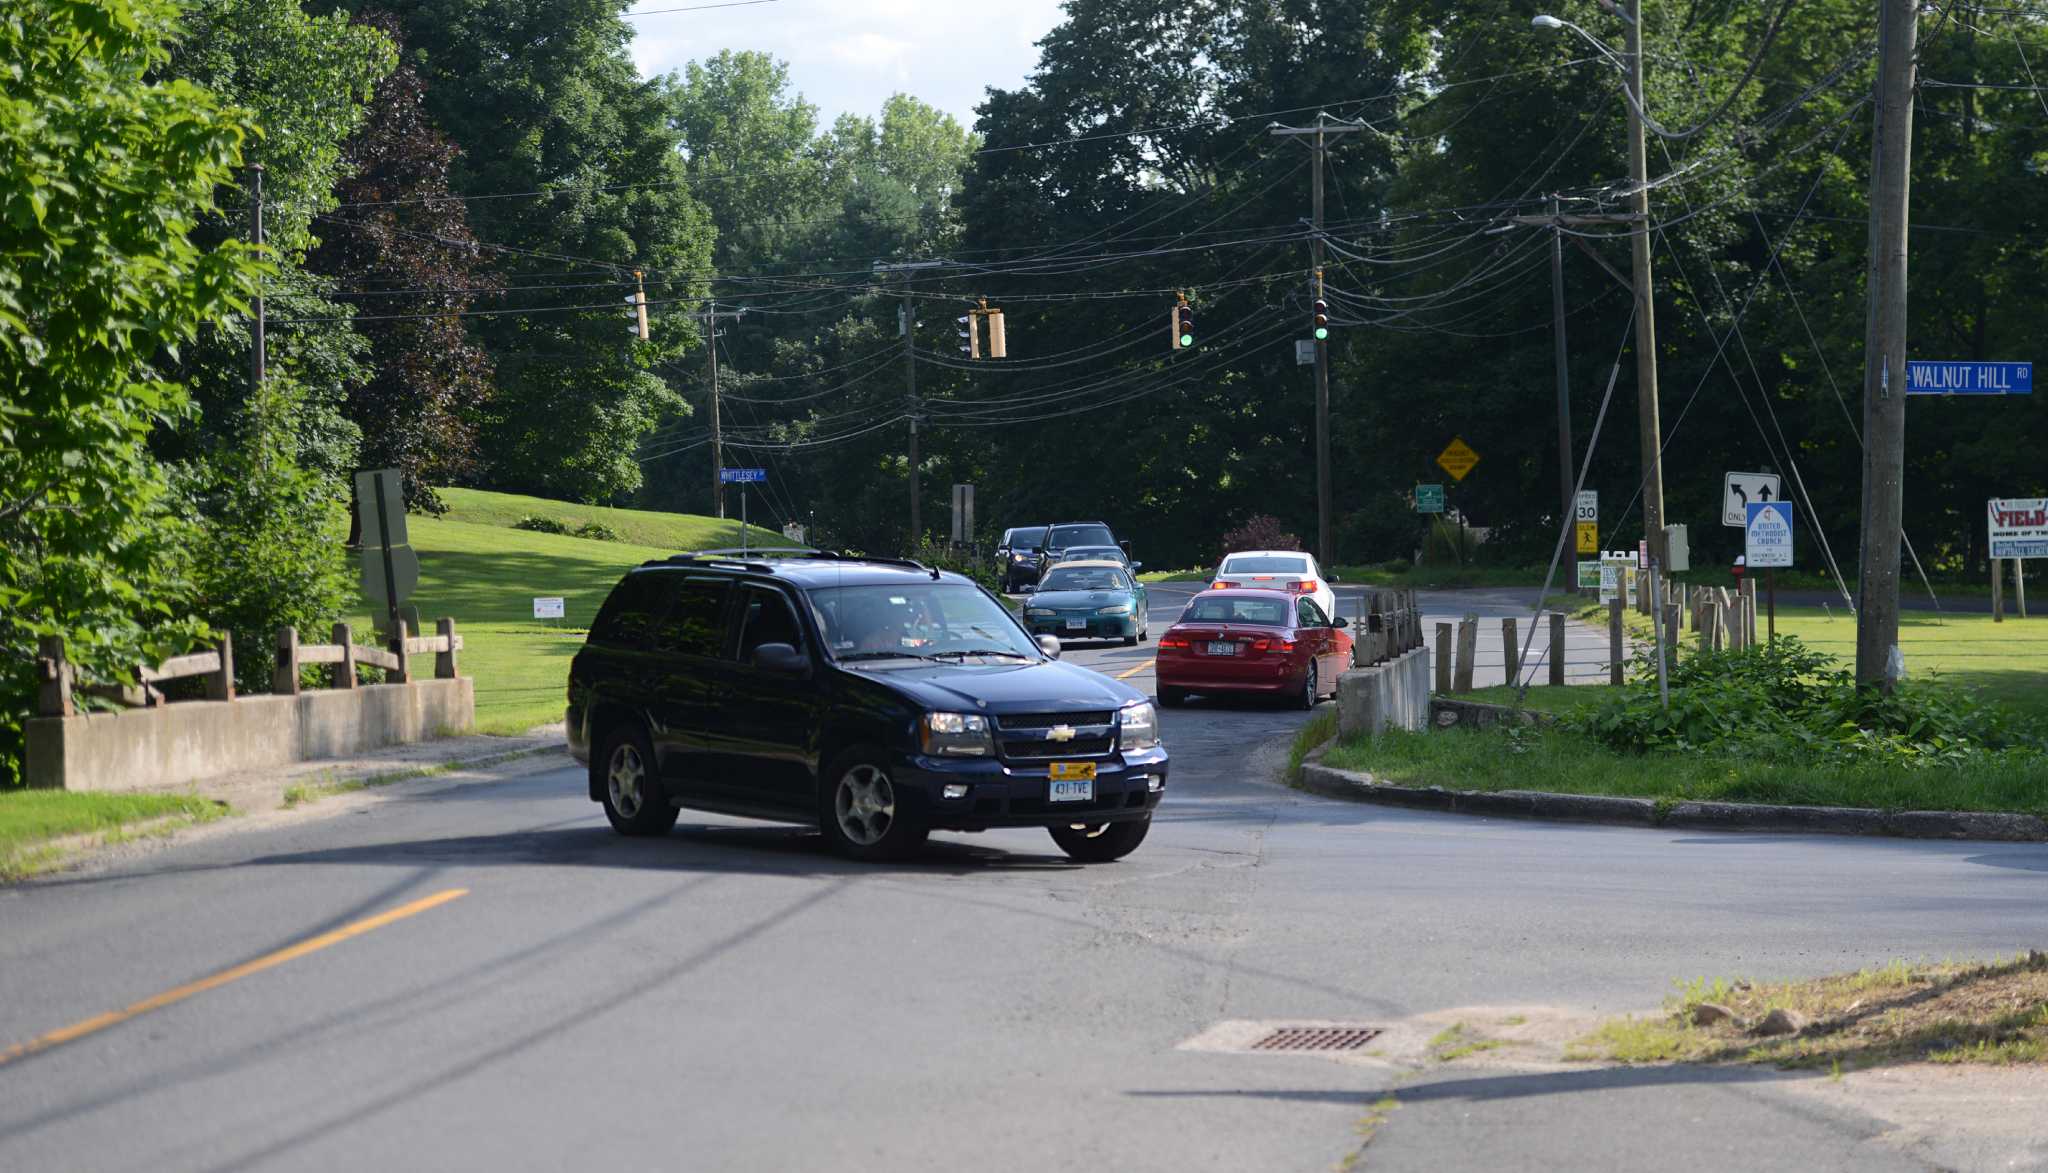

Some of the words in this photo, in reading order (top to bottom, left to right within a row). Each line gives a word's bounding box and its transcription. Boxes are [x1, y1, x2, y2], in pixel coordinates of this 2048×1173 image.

[1912, 366, 1971, 388] WALNUT
[1978, 366, 2011, 388] HILL
[2017, 367, 2028, 379] RD
[721, 471, 757, 480] WHITTLESEY
[1578, 507, 1595, 518] 30
[1728, 512, 1746, 521] ONLY
[1998, 510, 2045, 528] FIELD
[1757, 537, 1782, 545] CHURCH
